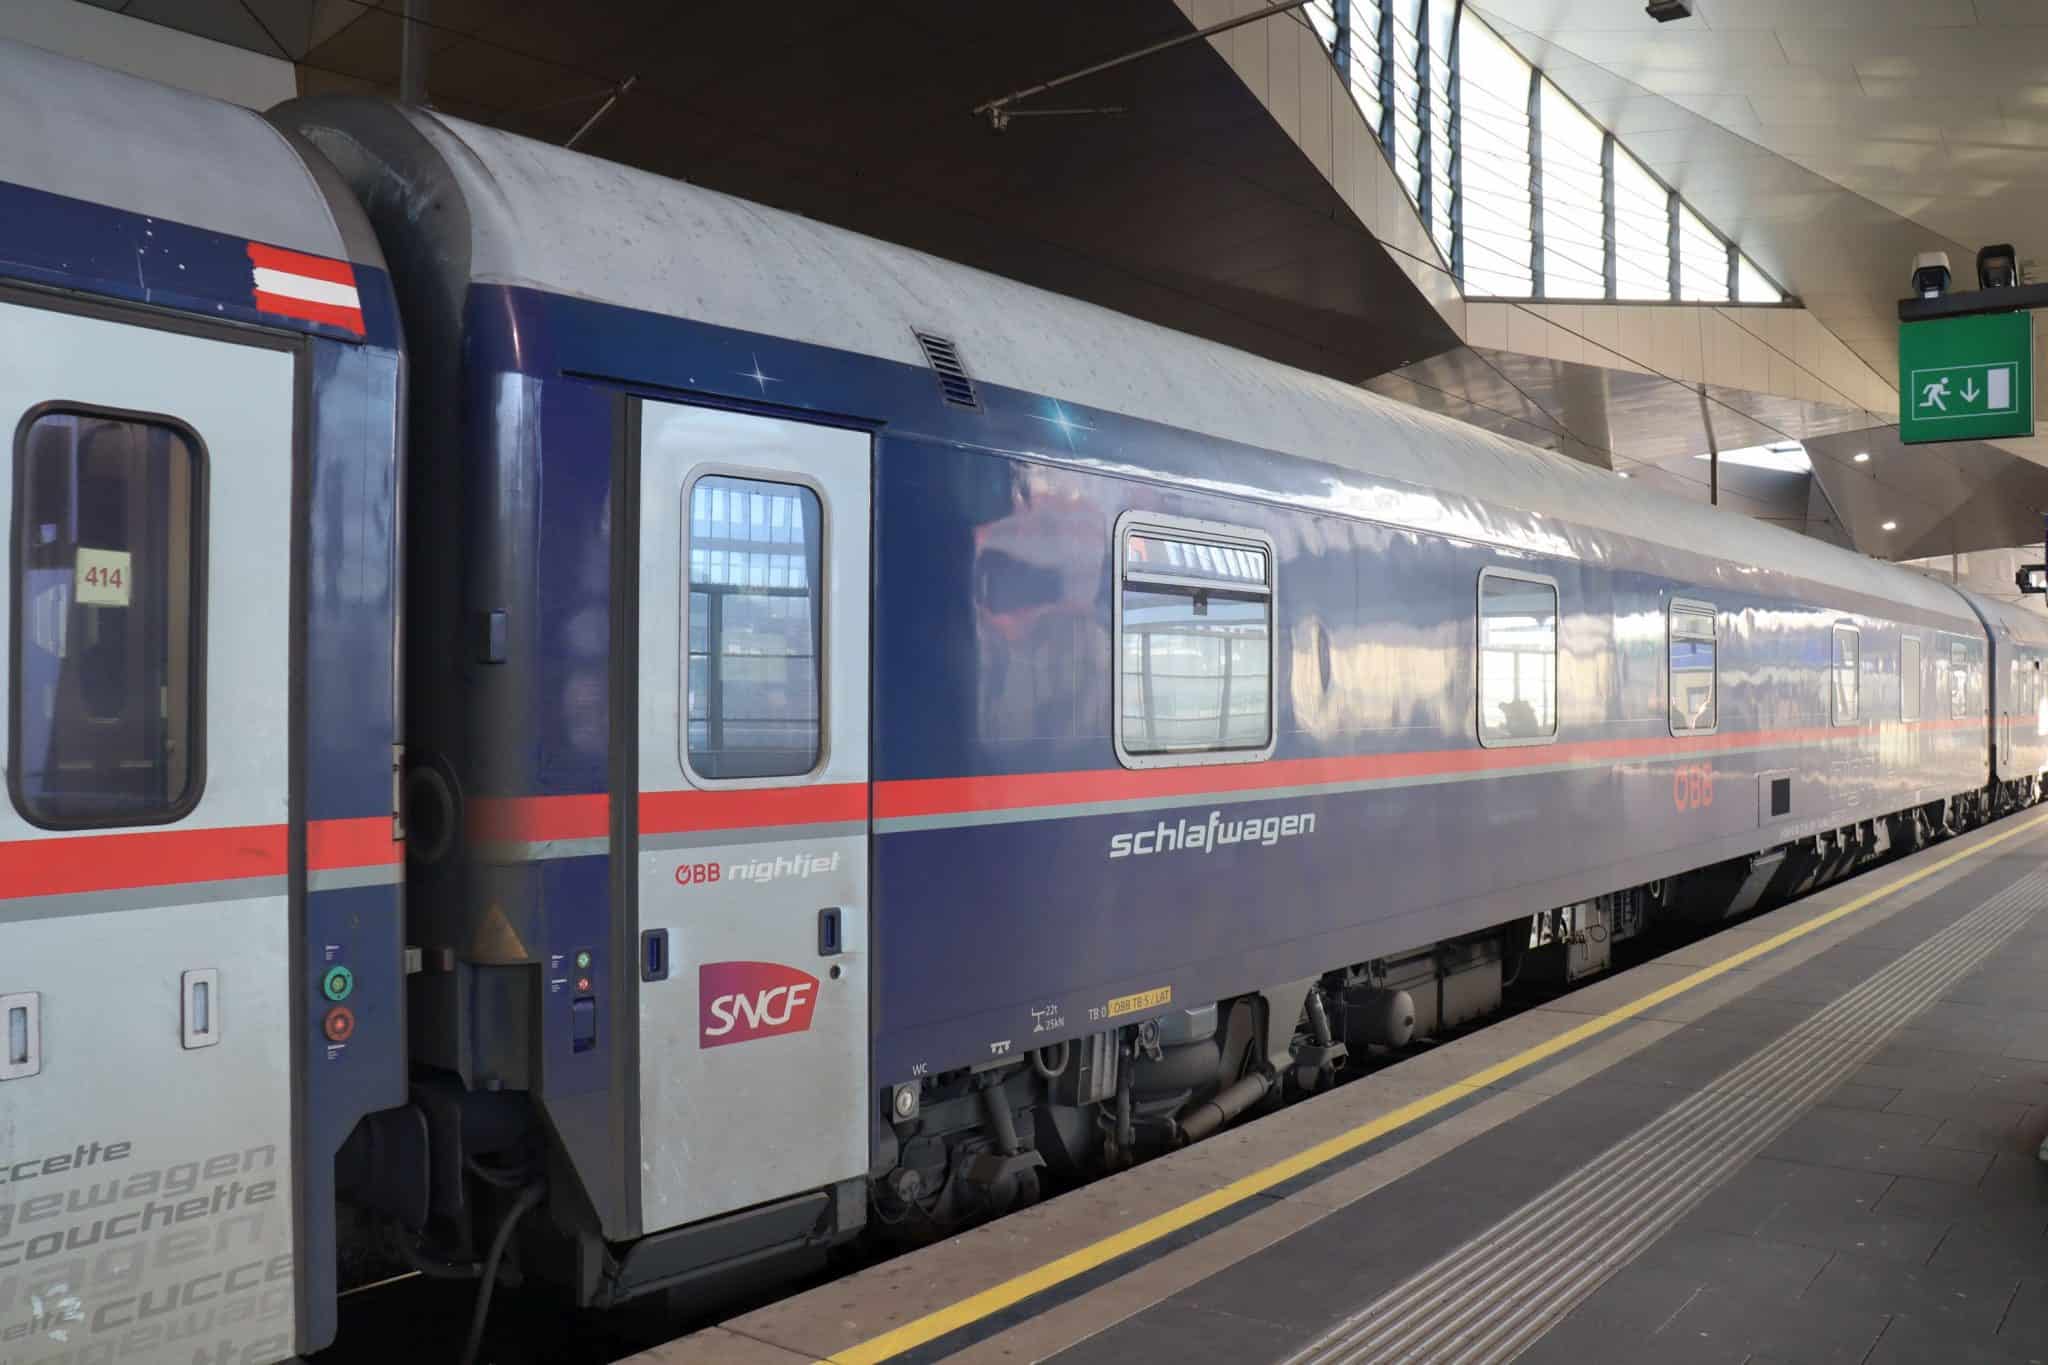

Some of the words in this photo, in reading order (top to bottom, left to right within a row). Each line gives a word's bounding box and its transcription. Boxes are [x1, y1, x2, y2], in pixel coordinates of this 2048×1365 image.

[85, 566, 122, 588] 414
[1110, 811, 1316, 858] schlafwagen
[675, 862, 720, 885] ÖBB
[728, 852, 840, 882] nightjet
[704, 983, 812, 1036] SNCF
[912, 1062, 928, 1077] WC
